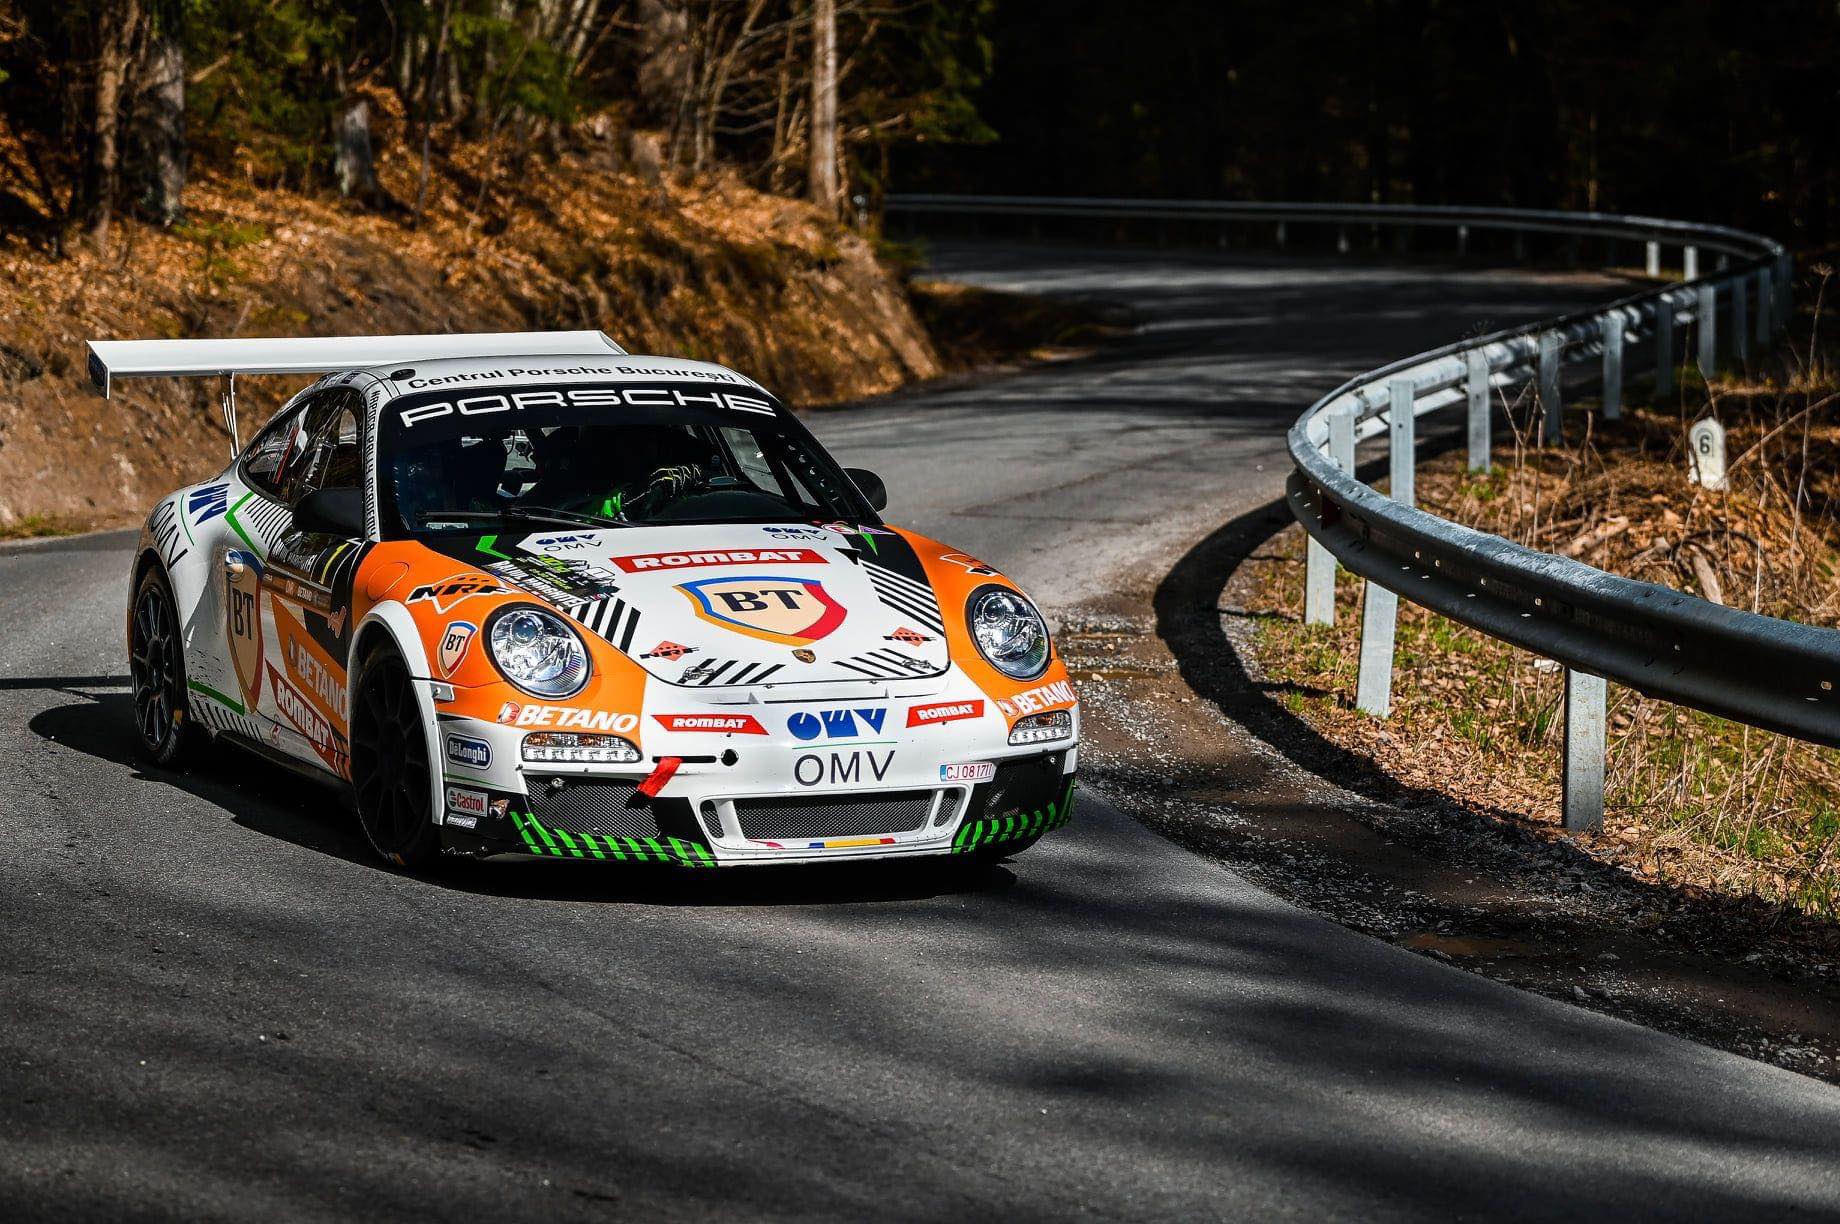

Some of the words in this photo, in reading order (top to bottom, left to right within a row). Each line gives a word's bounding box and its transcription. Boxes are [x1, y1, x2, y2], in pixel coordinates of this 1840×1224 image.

[408, 370, 504, 389] Centrul
[507, 365, 612, 377] Porsche
[400, 389, 777, 428] PORSCHE
[366, 435, 375, 474] RALLY
[1699, 434, 1711, 454] 6
[149, 500, 189, 572] OMV
[544, 540, 602, 552] OMV
[771, 533, 828, 541] OMV
[632, 551, 803, 570] ROMBAT
[714, 589, 803, 612] BT
[232, 587, 255, 641] BT
[446, 633, 466, 652] BT
[298, 643, 348, 721] BETANO
[1010, 679, 1076, 715] BETANO
[277, 678, 329, 753] ROMBAT
[514, 704, 639, 733] BETANO
[672, 717, 747, 729] ROMBAT
[916, 704, 975, 721] ROMBAT
[794, 750, 896, 787] OMV
[946, 765, 960, 779] CJ
[455, 792, 485, 812] Castrol
